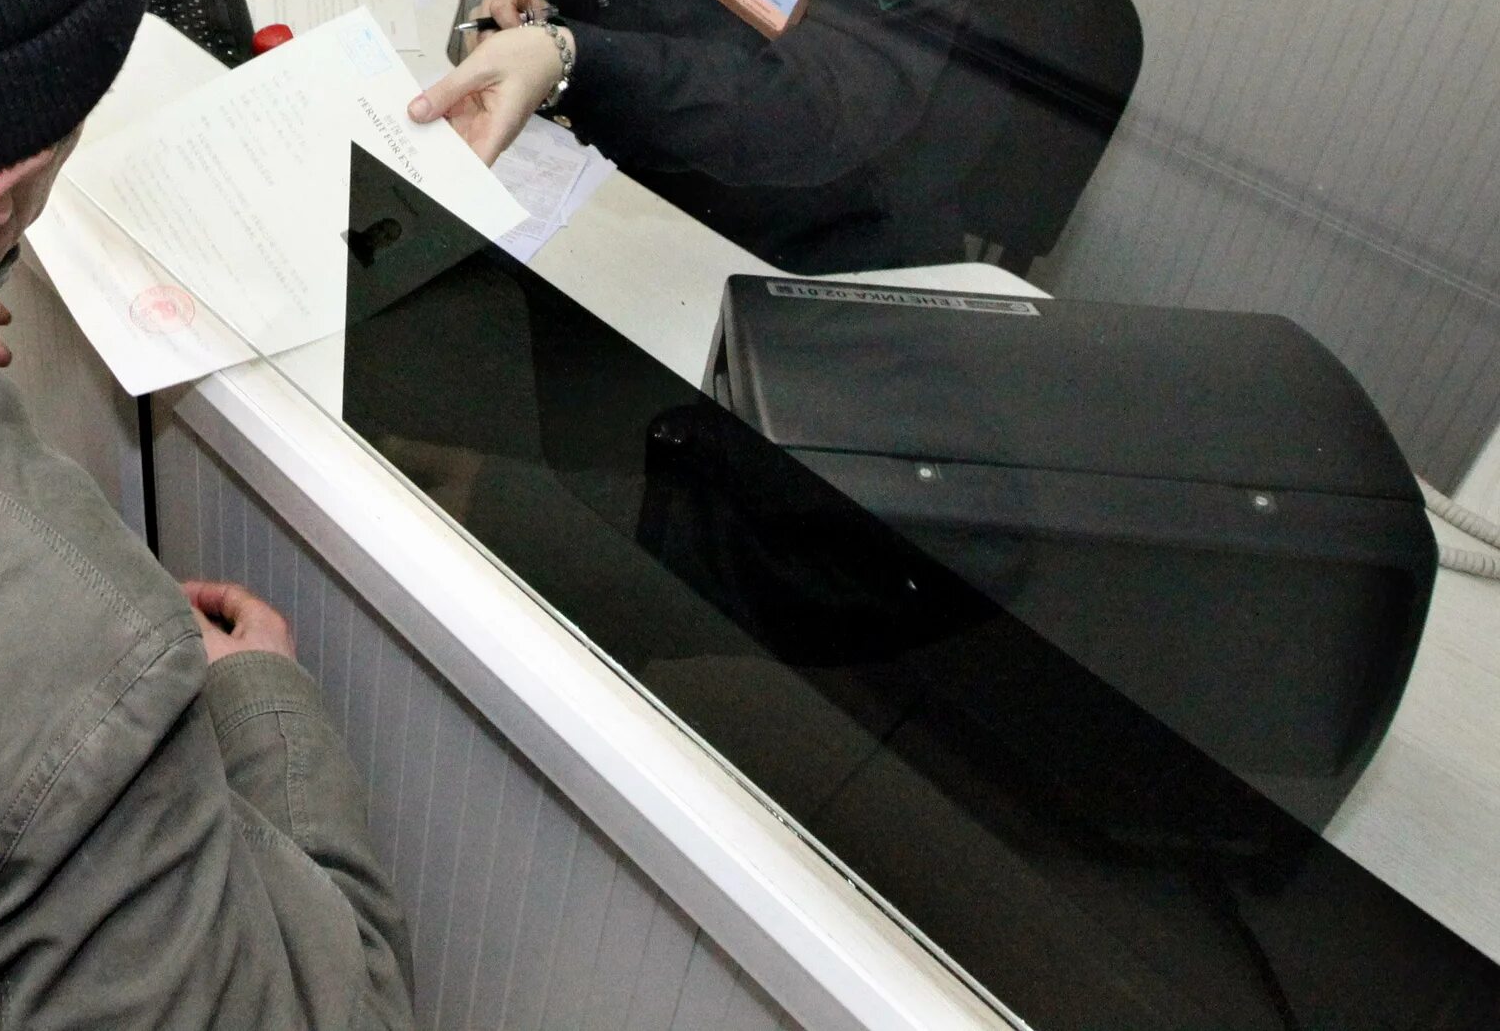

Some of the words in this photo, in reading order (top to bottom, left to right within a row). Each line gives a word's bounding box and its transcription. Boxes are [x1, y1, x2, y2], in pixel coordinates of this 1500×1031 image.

[357, 97, 387, 132] PERMIT
[383, 133, 401, 154] FOR
[398, 154, 424, 183] ENTRY
